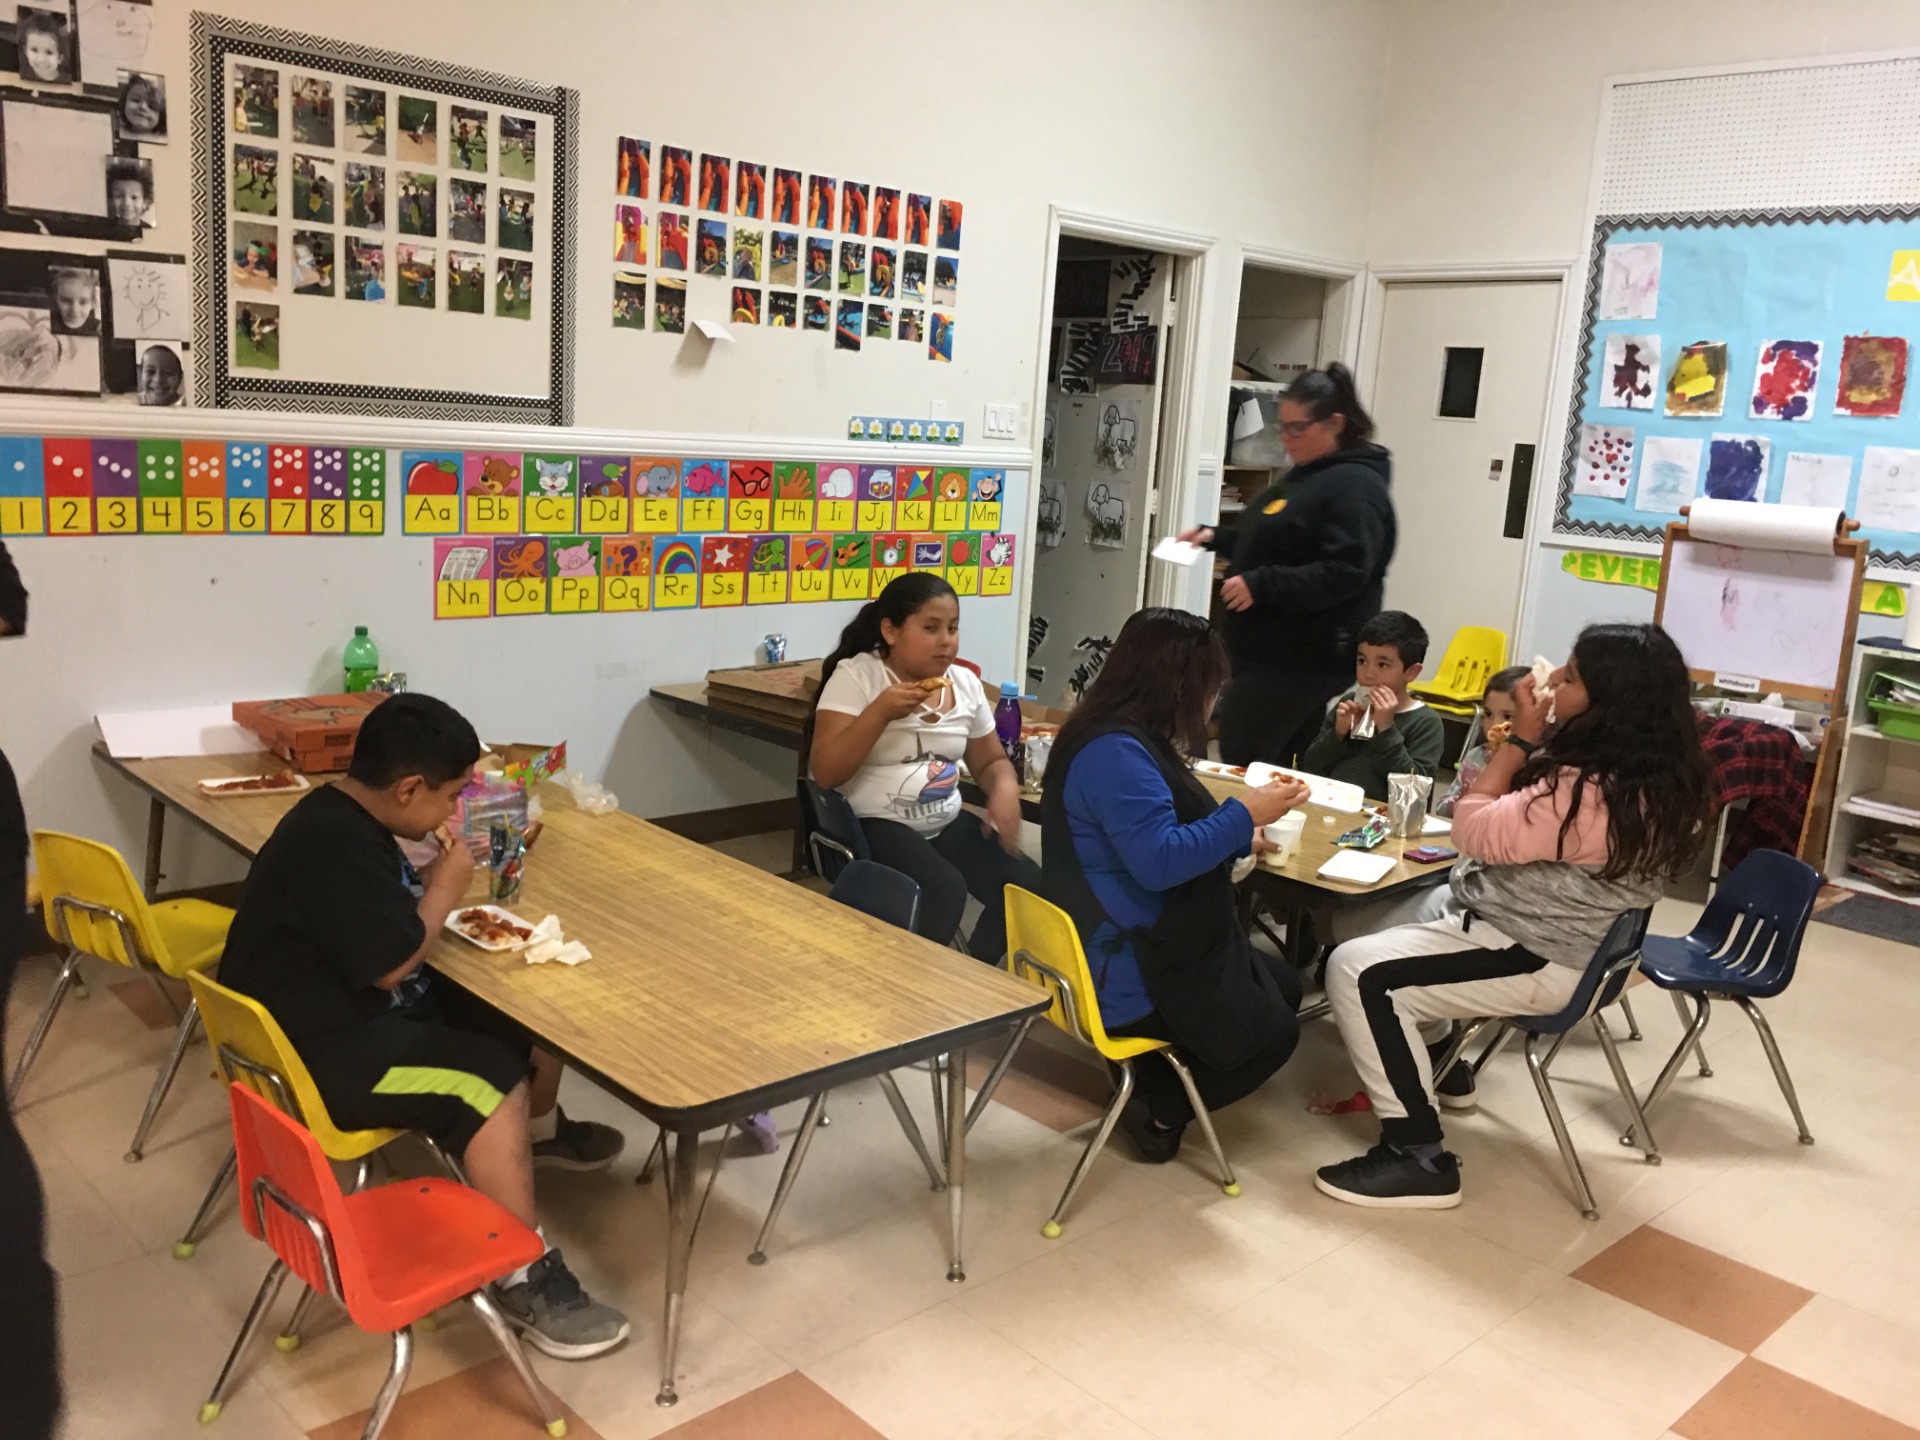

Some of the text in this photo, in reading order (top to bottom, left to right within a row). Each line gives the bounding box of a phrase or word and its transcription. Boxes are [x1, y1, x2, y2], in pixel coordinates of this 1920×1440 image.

[19, 500, 374, 530] 1 2 3 4 5 6 7 8 9
[414, 496, 998, 531] Aa Bb Cc Dd Ee Ff Gg Hh Ii Jj Kk Ll Mm
[447, 581, 480, 606] Nn
[504, 580, 539, 603] Oo
[561, 577, 590, 611] Pp
[608, 577, 644, 609] Qq
[663, 575, 689, 596] Rr
[711, 574, 735, 596] Ss
[757, 572, 779, 593] Tt
[799, 572, 822, 592] Uu
[841, 570, 861, 590] Vv
[954, 568, 971, 593] Yy
[988, 567, 1006, 587] Zz
[1875, 584, 1902, 613] A
